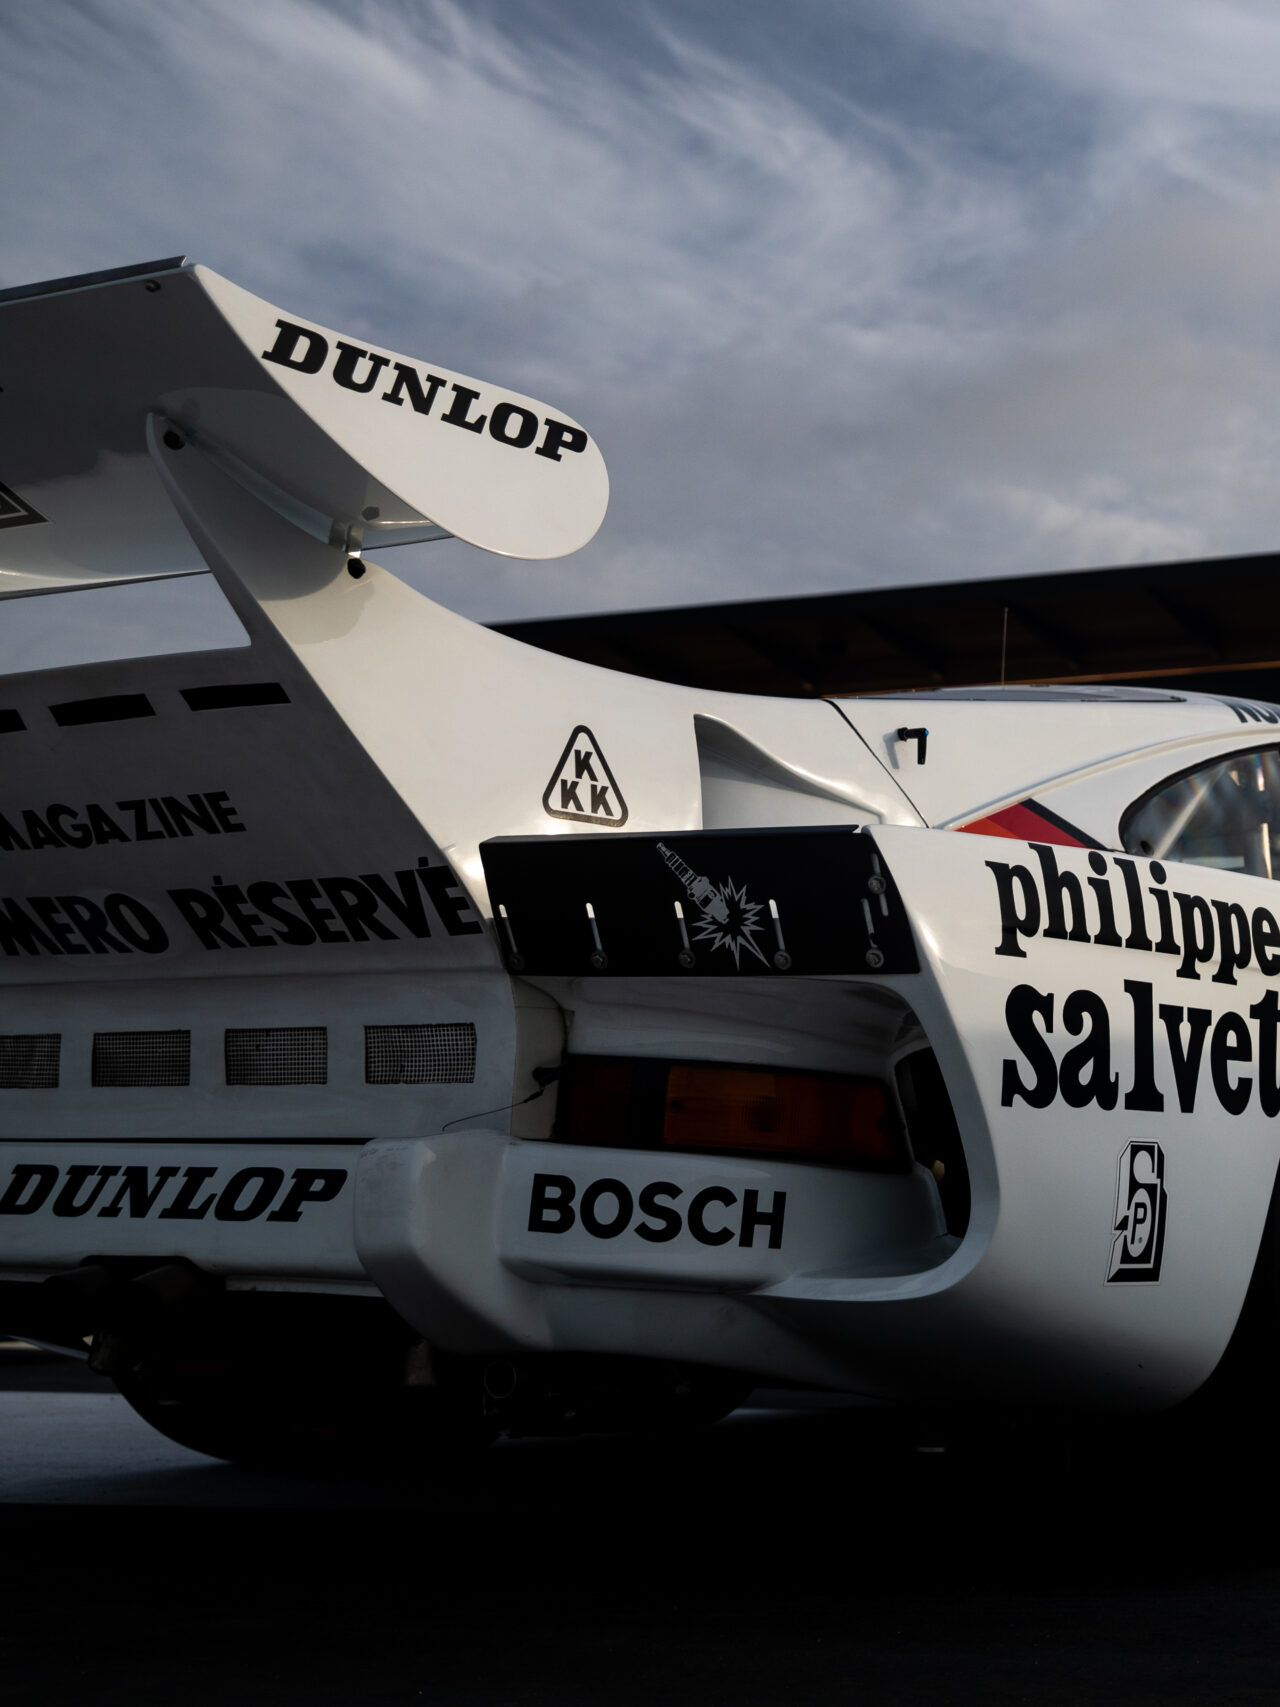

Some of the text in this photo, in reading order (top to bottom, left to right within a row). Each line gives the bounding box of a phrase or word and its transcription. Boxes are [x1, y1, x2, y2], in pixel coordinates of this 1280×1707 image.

[261, 318, 588, 462] DUNLOP
[167, 856, 483, 950] RÉSERVÉ
[0, 1164, 348, 1222] DUNLOP
[528, 1173, 786, 1249] BOSCH
